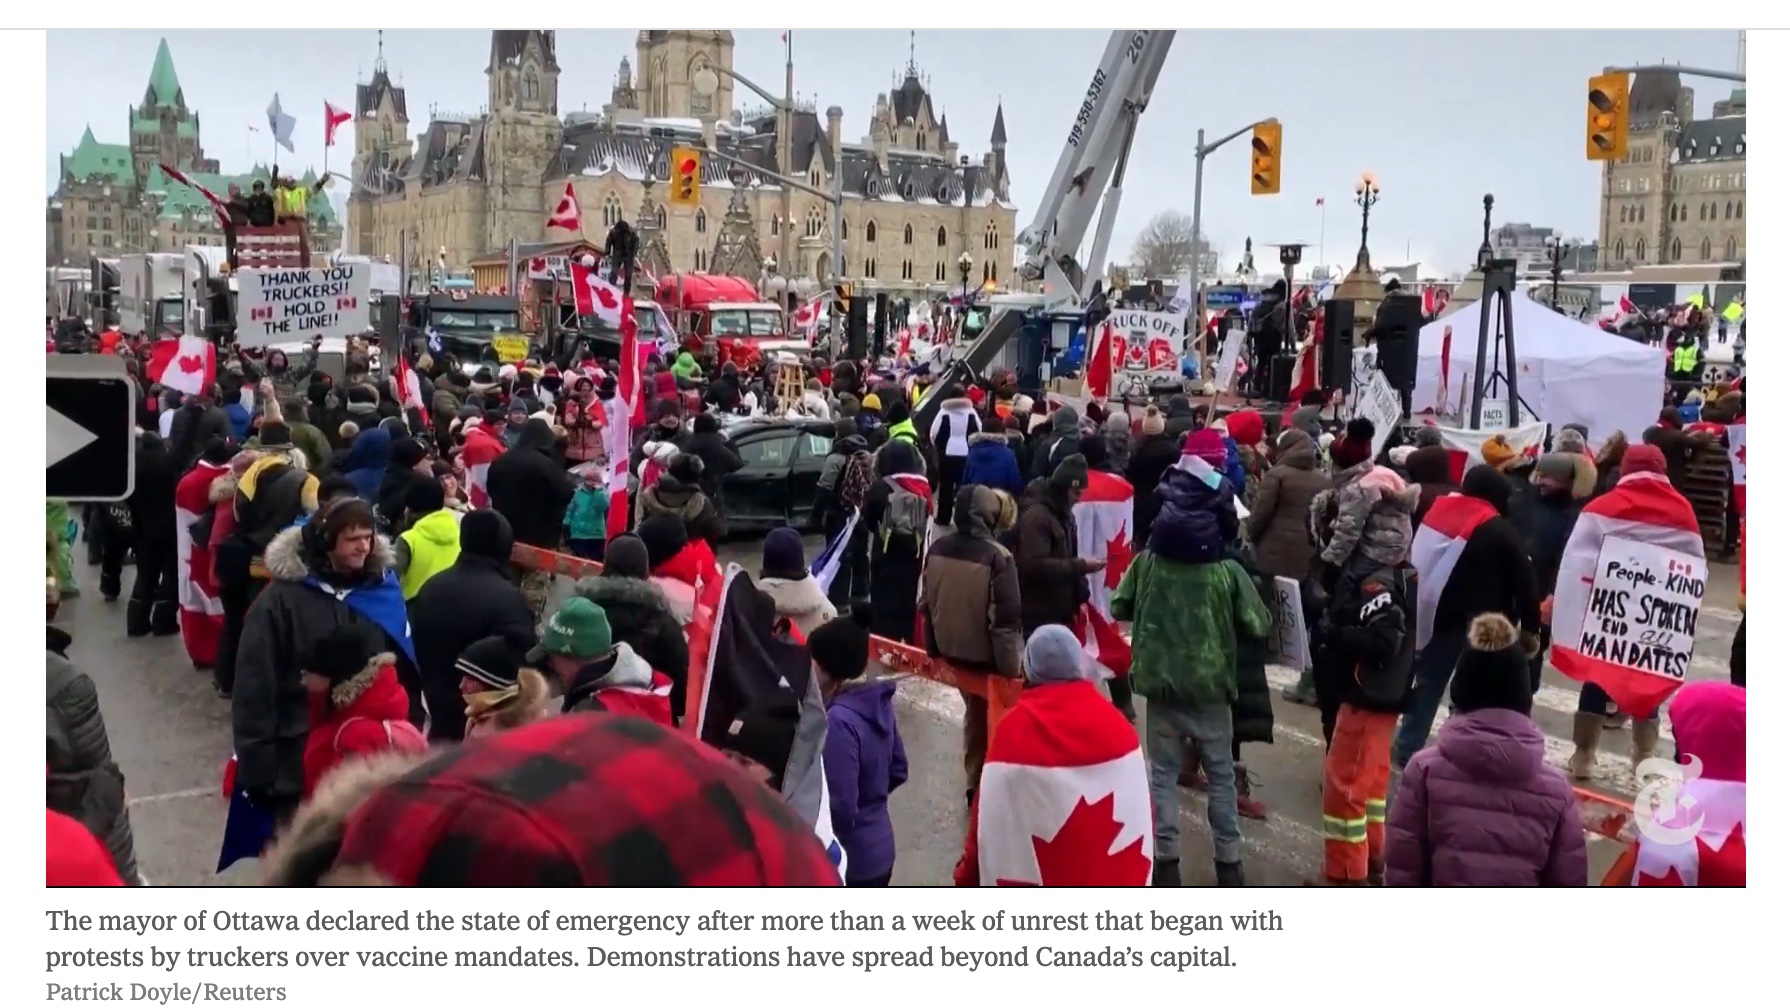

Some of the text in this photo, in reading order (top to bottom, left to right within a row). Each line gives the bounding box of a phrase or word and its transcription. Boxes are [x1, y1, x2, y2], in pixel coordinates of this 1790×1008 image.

[1067, 68, 1107, 148] 519-550-5362
[259, 265, 353, 287] THANK YOU
[262, 281, 349, 302] TRUCKERS!!
[284, 300, 326, 317] HOLD
[263, 312, 339, 335] THE LINE!!
[1152, 317, 1180, 338] OFF
[1483, 408, 1503, 420] FACTS
[1591, 587, 1699, 637] HAS SPOKEN
